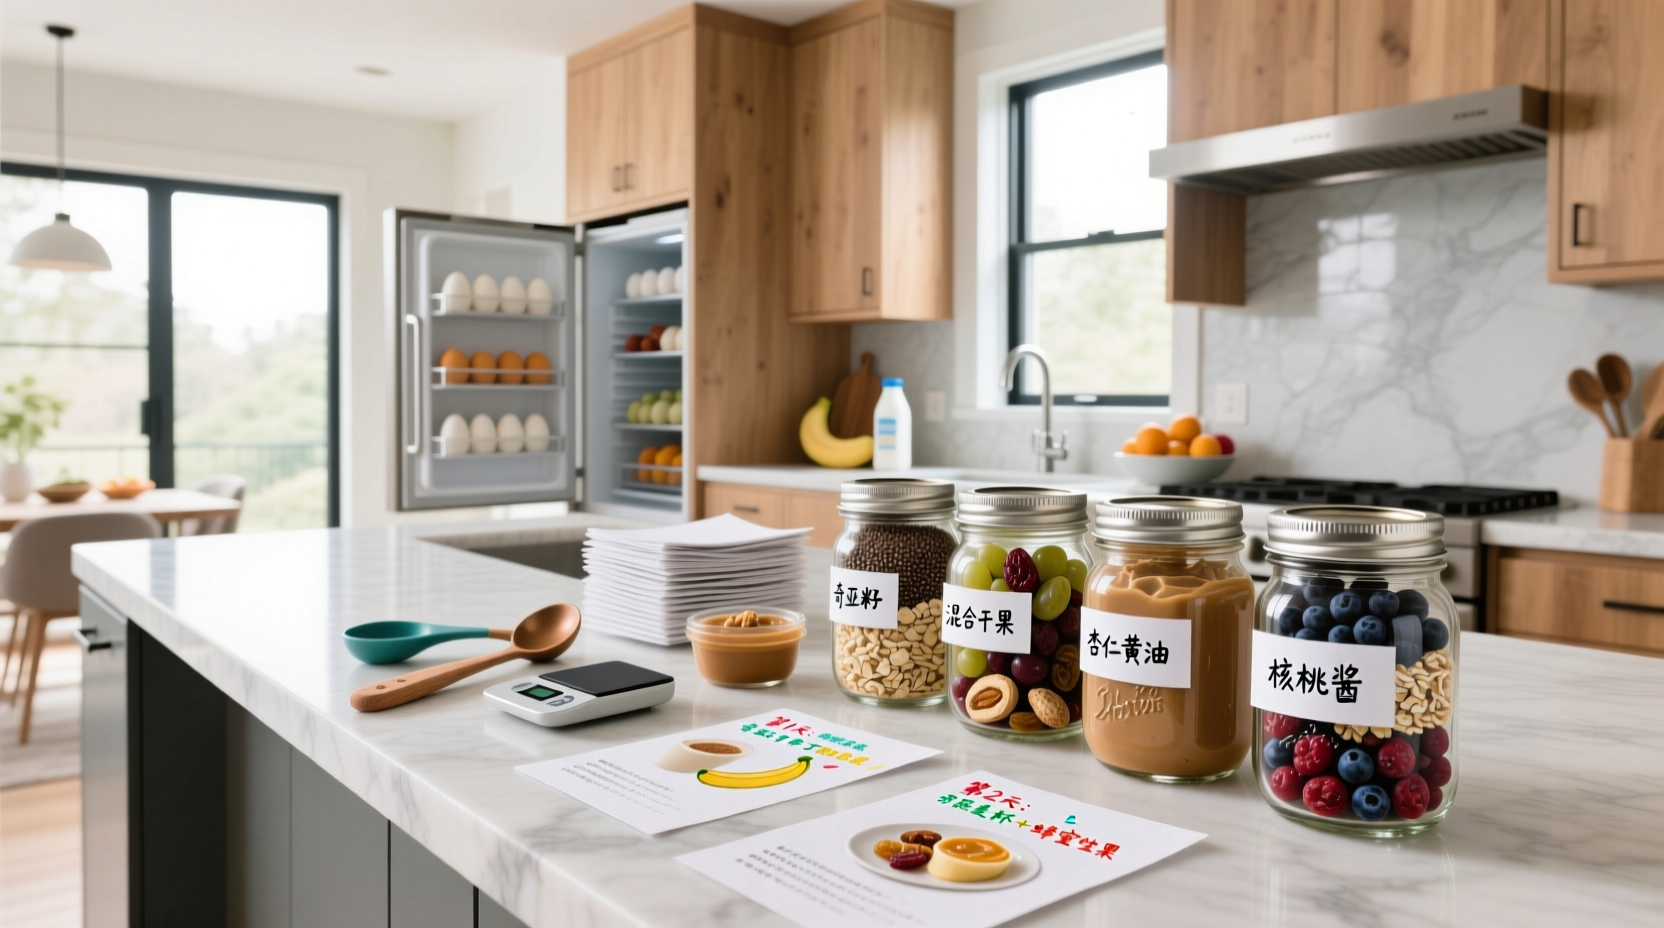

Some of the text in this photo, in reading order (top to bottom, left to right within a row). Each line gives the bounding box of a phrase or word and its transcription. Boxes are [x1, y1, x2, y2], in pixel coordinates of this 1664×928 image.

[834, 583, 882, 609] 奇亚籽
[947, 605, 1013, 635] 混合干果
[1088, 629, 1169, 665] 杏仁黄油
[1268, 658, 1362, 703] 核桃酱
